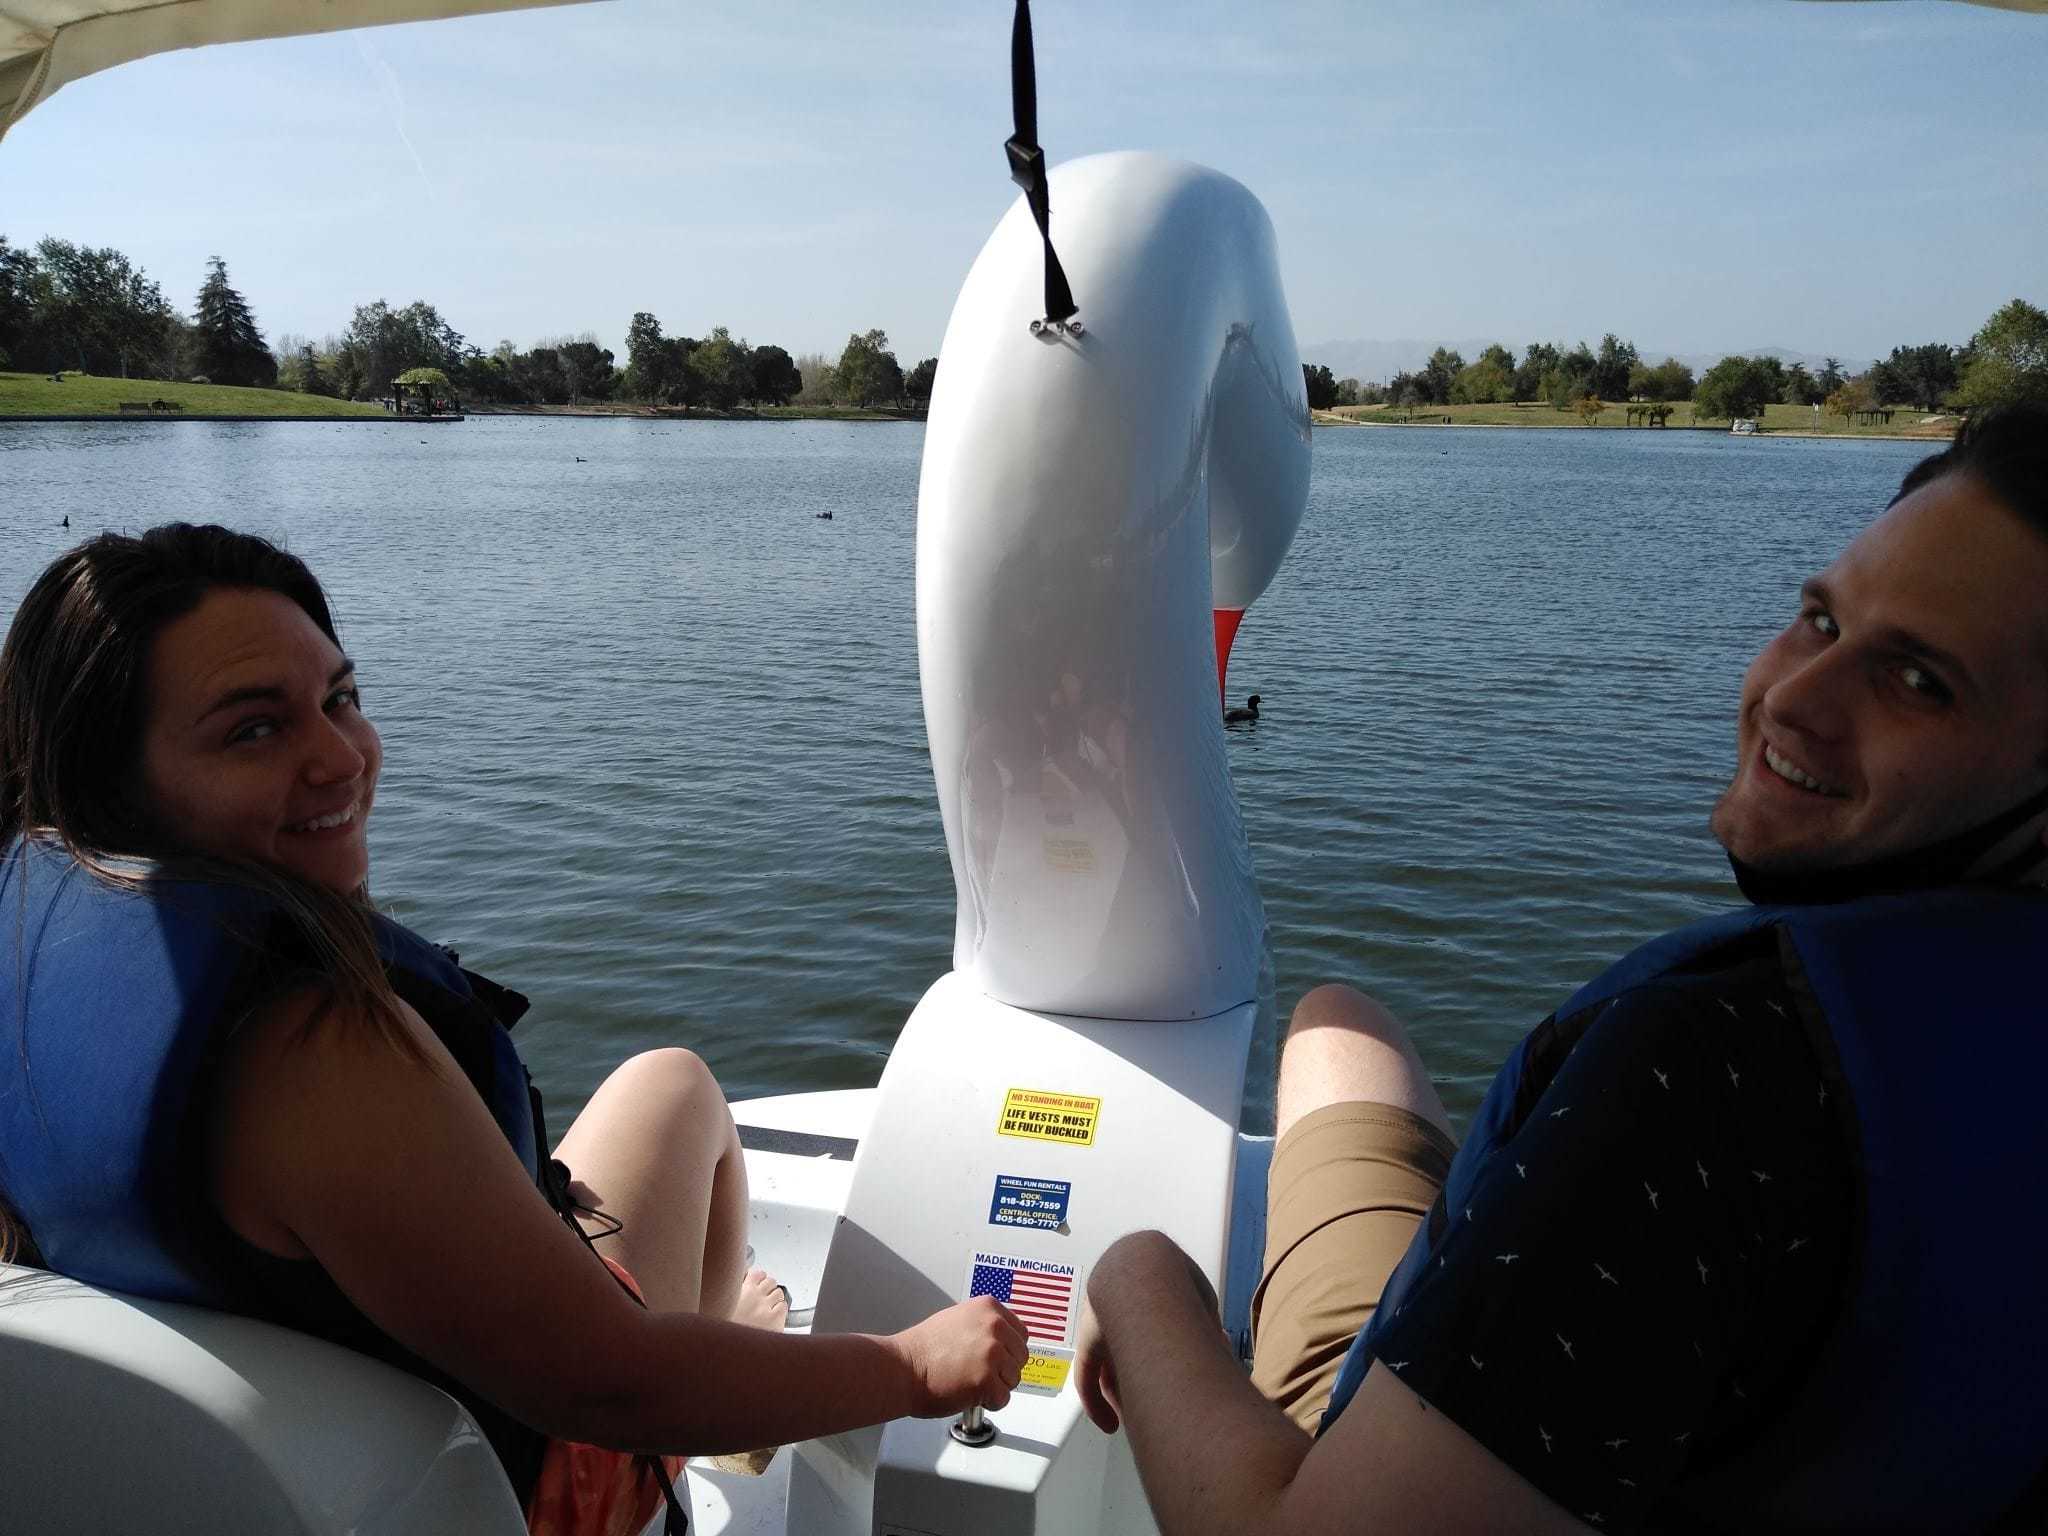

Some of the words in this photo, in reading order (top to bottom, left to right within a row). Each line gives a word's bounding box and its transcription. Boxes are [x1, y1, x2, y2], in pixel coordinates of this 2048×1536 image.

[1011, 1093, 1023, 1101] NO
[1023, 1094, 1063, 1106] STANDING
[1064, 1099, 1073, 1108] IN
[1073, 1100, 1095, 1110] BOAT
[1006, 1108, 1026, 1120] LIFE
[1028, 1110, 1060, 1123] VESTS
[1062, 1115, 1093, 1127] MUST
[1004, 1120, 1016, 1130] BE
[1017, 1121, 1043, 1134] FULLY
[1044, 1125, 1089, 1139] BUCKLED
[1000, 1178, 1023, 1186] WHEEL
[1023, 1180, 1037, 1188] FUN
[1037, 1181, 1066, 1190] RENTALS
[1000, 1196, 1061, 1210] 818-437-7559
[999, 1208, 1031, 1217] CENTRAL
[995, 1214, 1059, 1228] 805-650-7770
[975, 1253, 1006, 1266] MADE
[1008, 1259, 1019, 1268] IN
[1020, 1260, 1074, 1275] MICHIGAN
